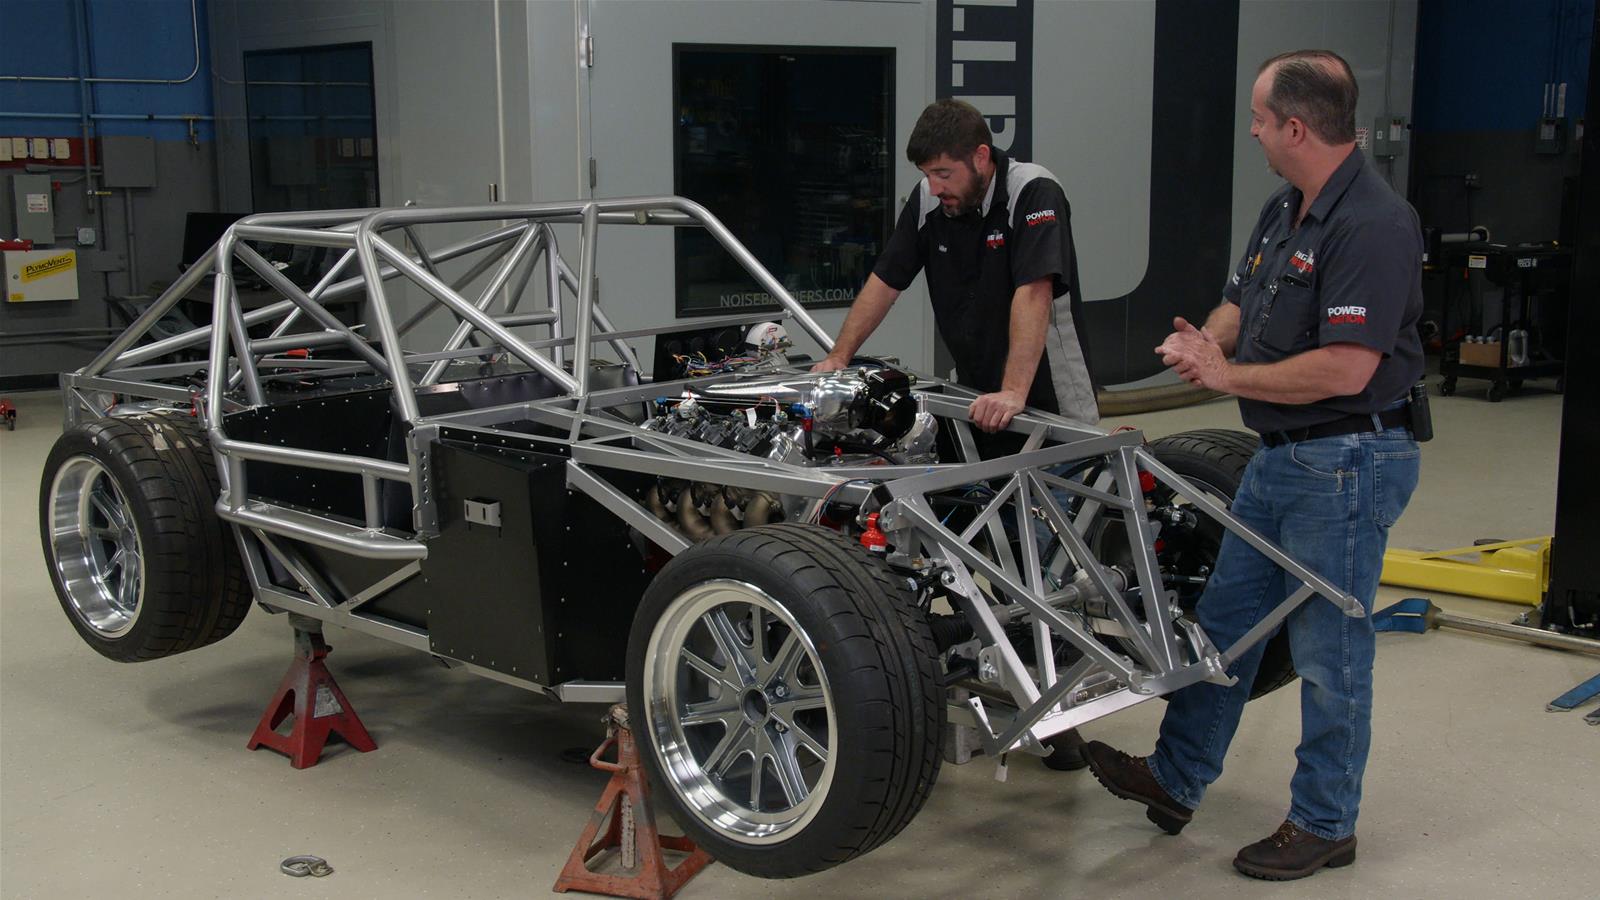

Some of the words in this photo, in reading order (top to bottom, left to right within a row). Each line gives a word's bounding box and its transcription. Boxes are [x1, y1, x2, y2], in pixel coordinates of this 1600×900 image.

[1026, 210, 1055, 221] POWER
[720, 288, 854, 307] NOISEBAIERS.COM
[1327, 306, 1366, 317] POWER
